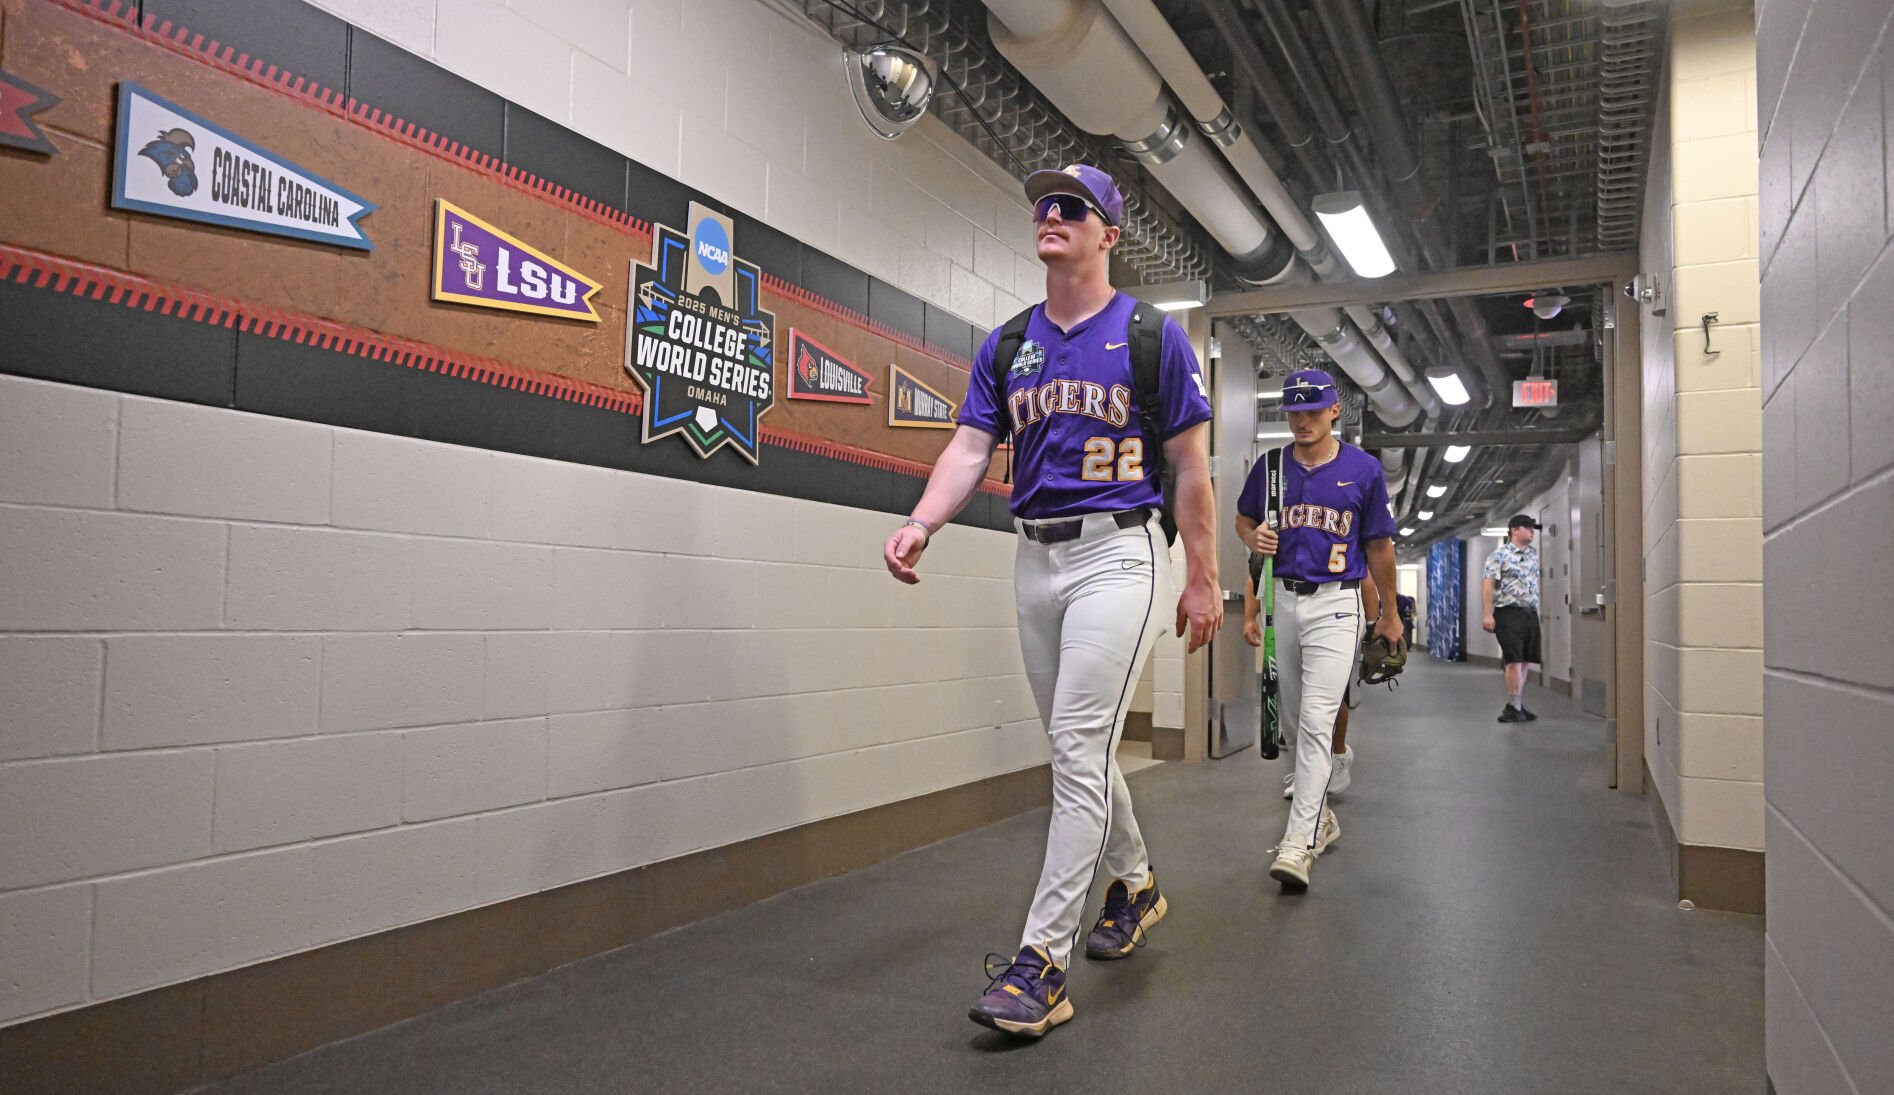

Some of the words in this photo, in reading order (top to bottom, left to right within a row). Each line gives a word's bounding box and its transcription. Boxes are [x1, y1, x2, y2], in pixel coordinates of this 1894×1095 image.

[211, 146, 273, 214] COASTAL
[277, 175, 340, 228] CAROLINA
[697, 240, 728, 267] NCAA
[495, 246, 577, 305] LSU
[677, 294, 707, 315] 2025
[708, 305, 740, 326] MEN'S
[668, 309, 748, 361] COLLEGE
[636, 333, 707, 382] WORLD
[708, 357, 770, 400] SERIES
[819, 356, 863, 395] LOUISVILLE
[687, 385, 727, 407] OMAHA
[1007, 378, 1131, 436] TIGERS
[1521, 381, 1552, 404] EXIT
[1081, 436, 1144, 482] 22
[1279, 503, 1353, 538] IGERS
[1327, 543, 1348, 573] 5
